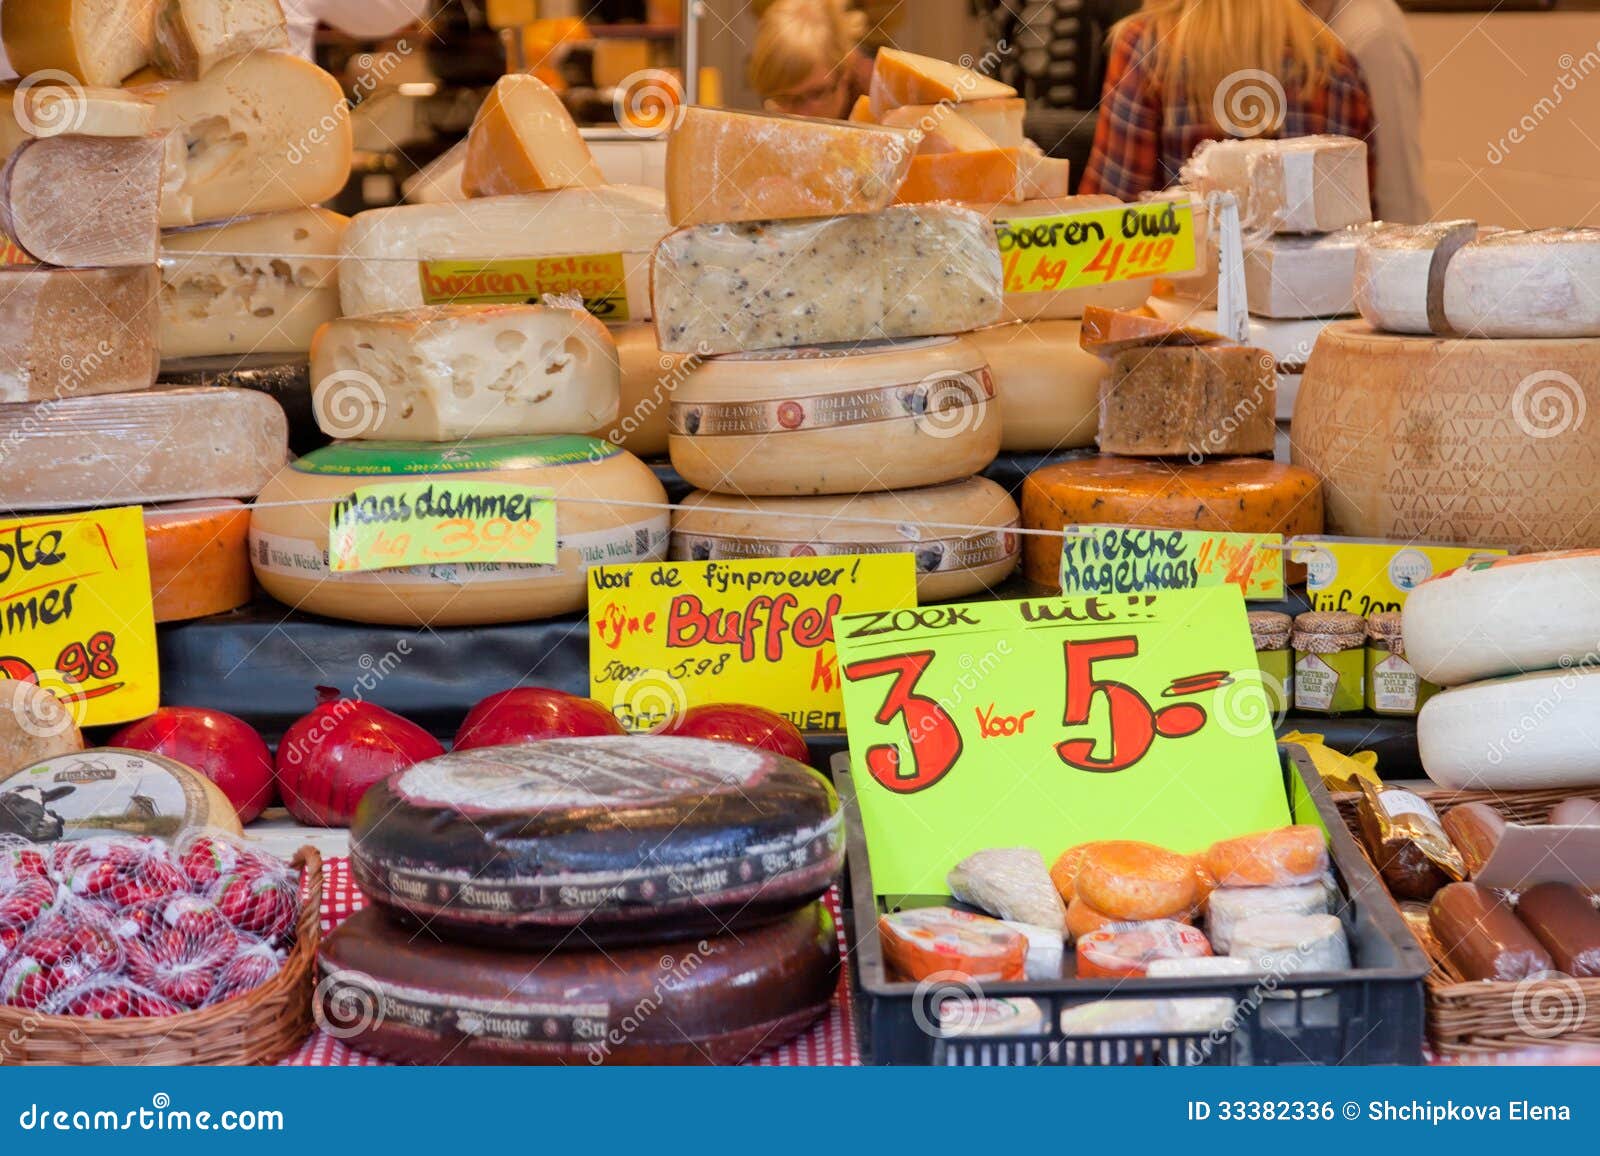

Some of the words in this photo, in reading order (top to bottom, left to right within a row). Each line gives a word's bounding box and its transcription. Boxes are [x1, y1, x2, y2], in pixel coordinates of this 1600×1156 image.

[1122, 202, 1180, 239] Oud
[421, 260, 529, 297] boeren
[1029, 254, 1068, 291] kg
[367, 530, 411, 560] kg
[593, 567, 632, 590] Voor
[650, 566, 682, 587] de
[667, 653, 731, 680] 5.98
[843, 649, 964, 795] 3
